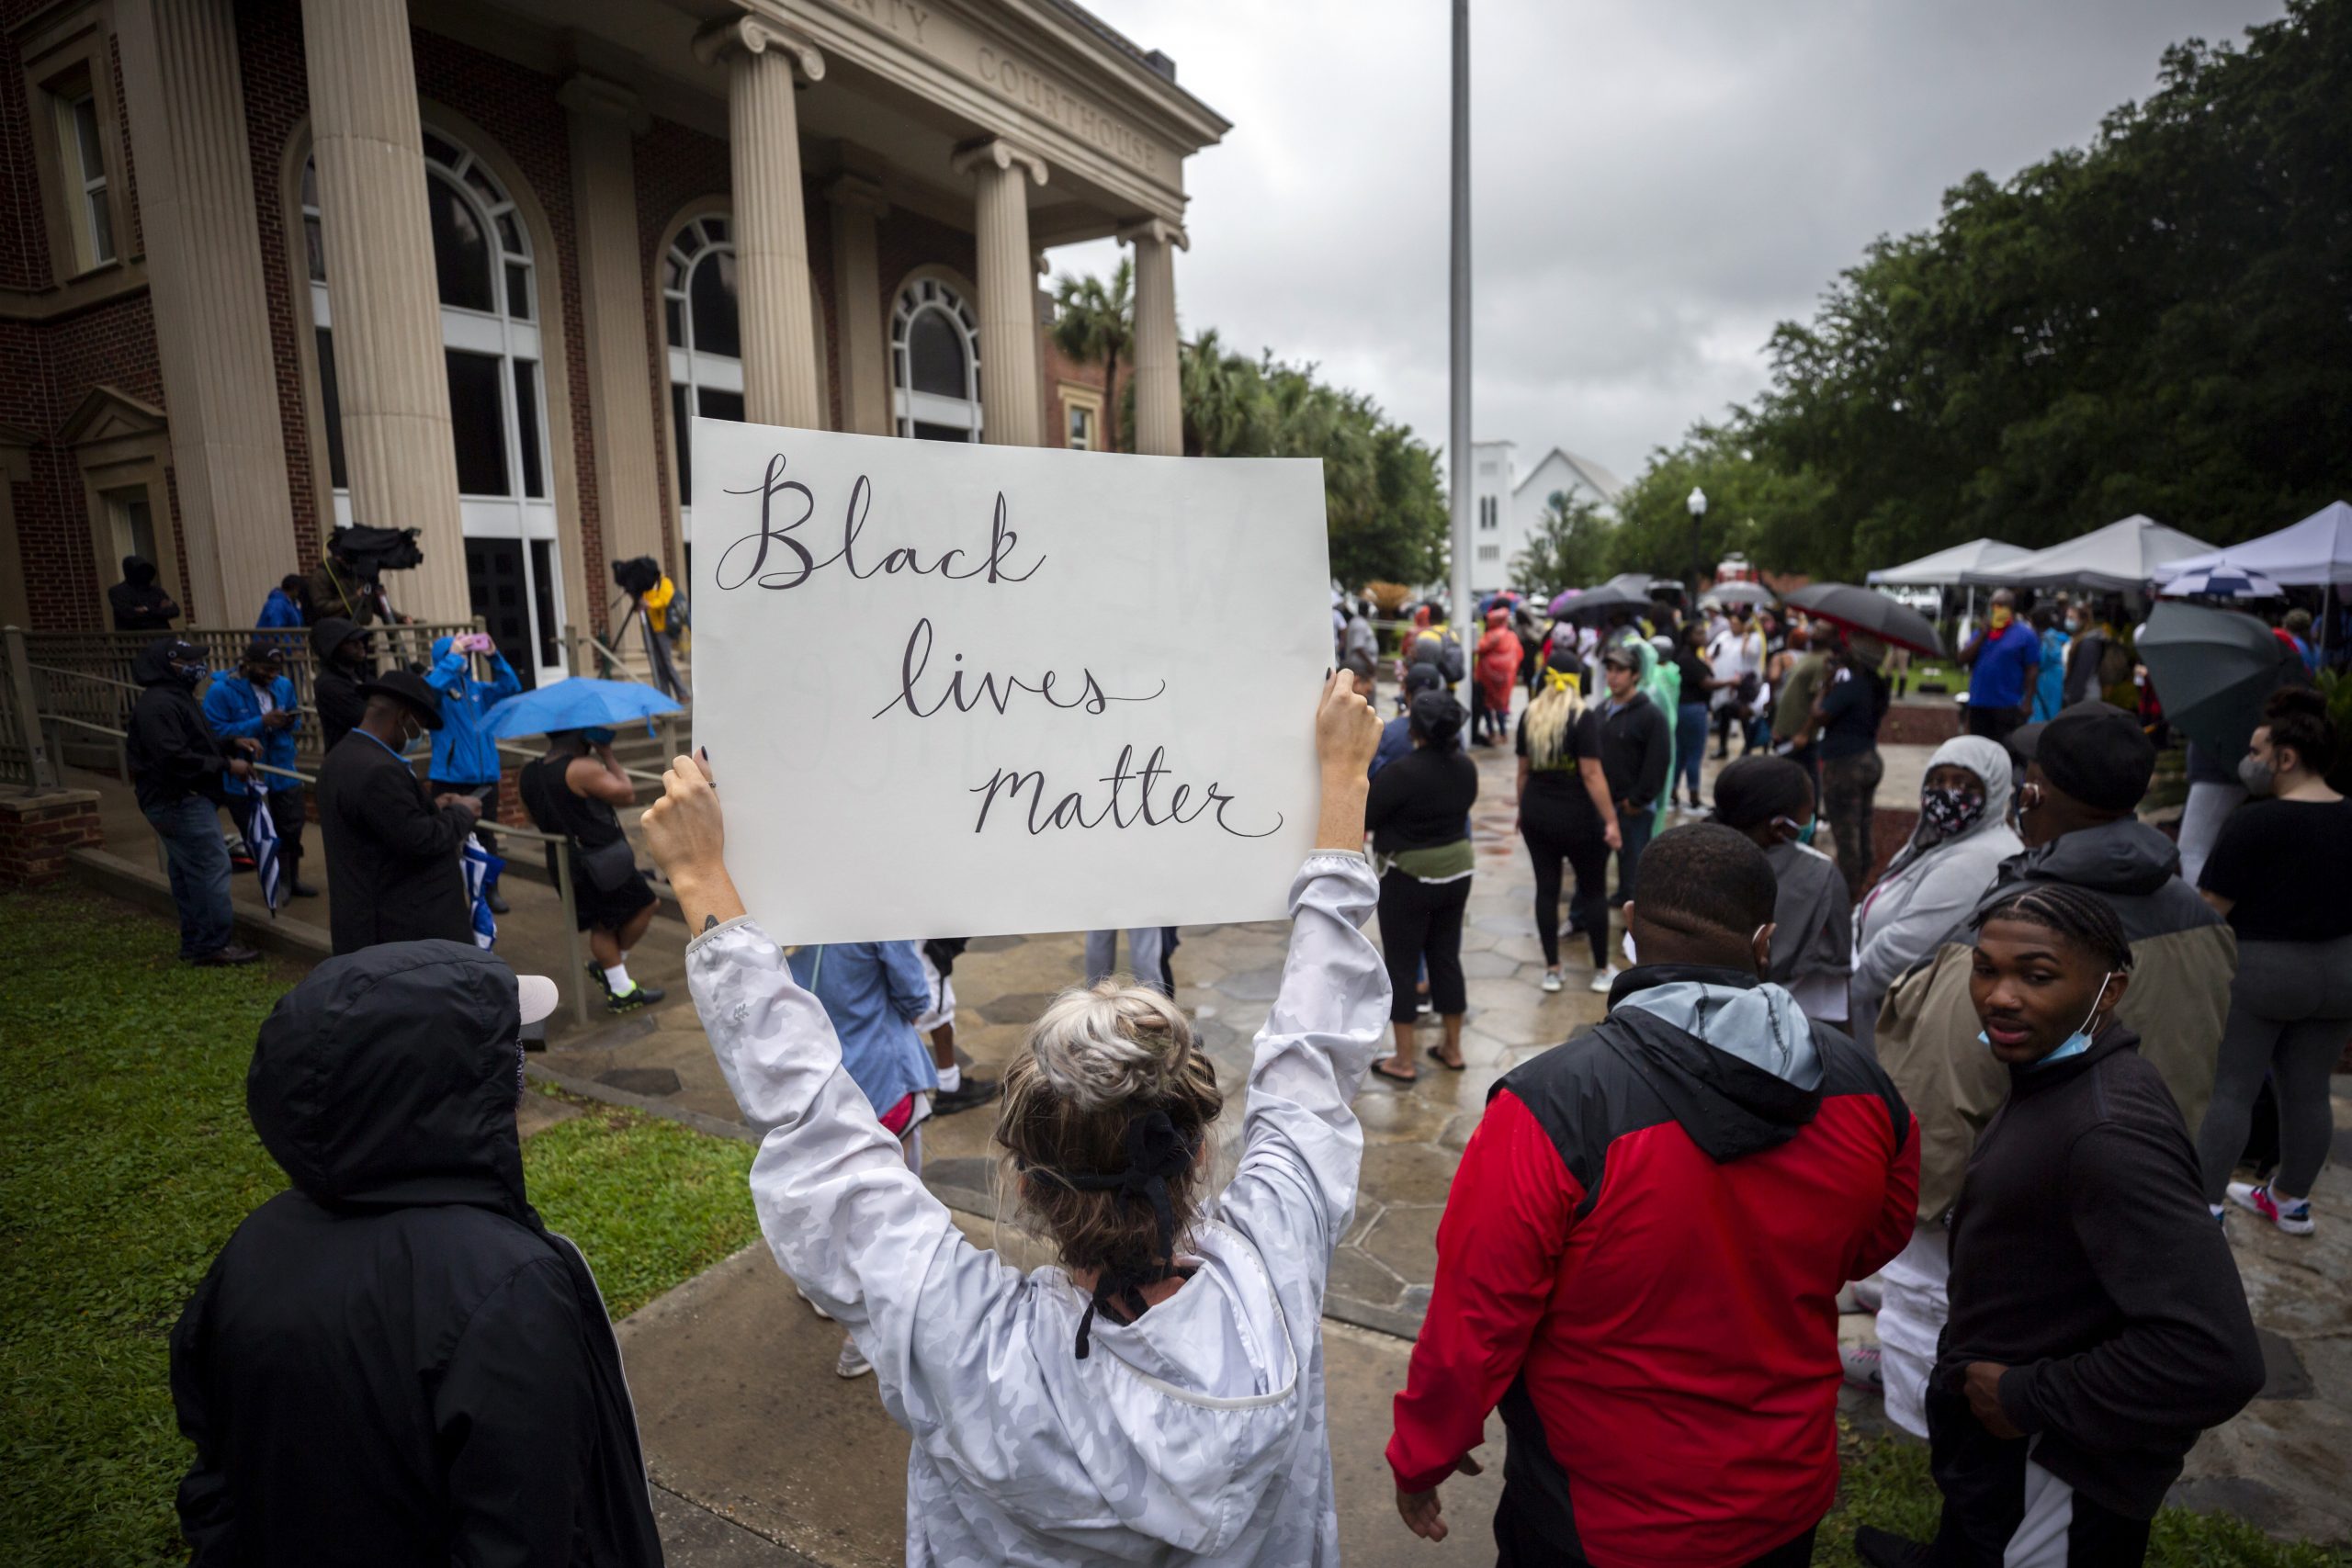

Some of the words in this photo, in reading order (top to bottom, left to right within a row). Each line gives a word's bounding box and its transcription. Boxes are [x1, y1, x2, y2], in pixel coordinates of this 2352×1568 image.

[978, 46, 1158, 172] COURTHOUSE
[716, 453, 1046, 590] Black
[872, 617, 1166, 719] lives
